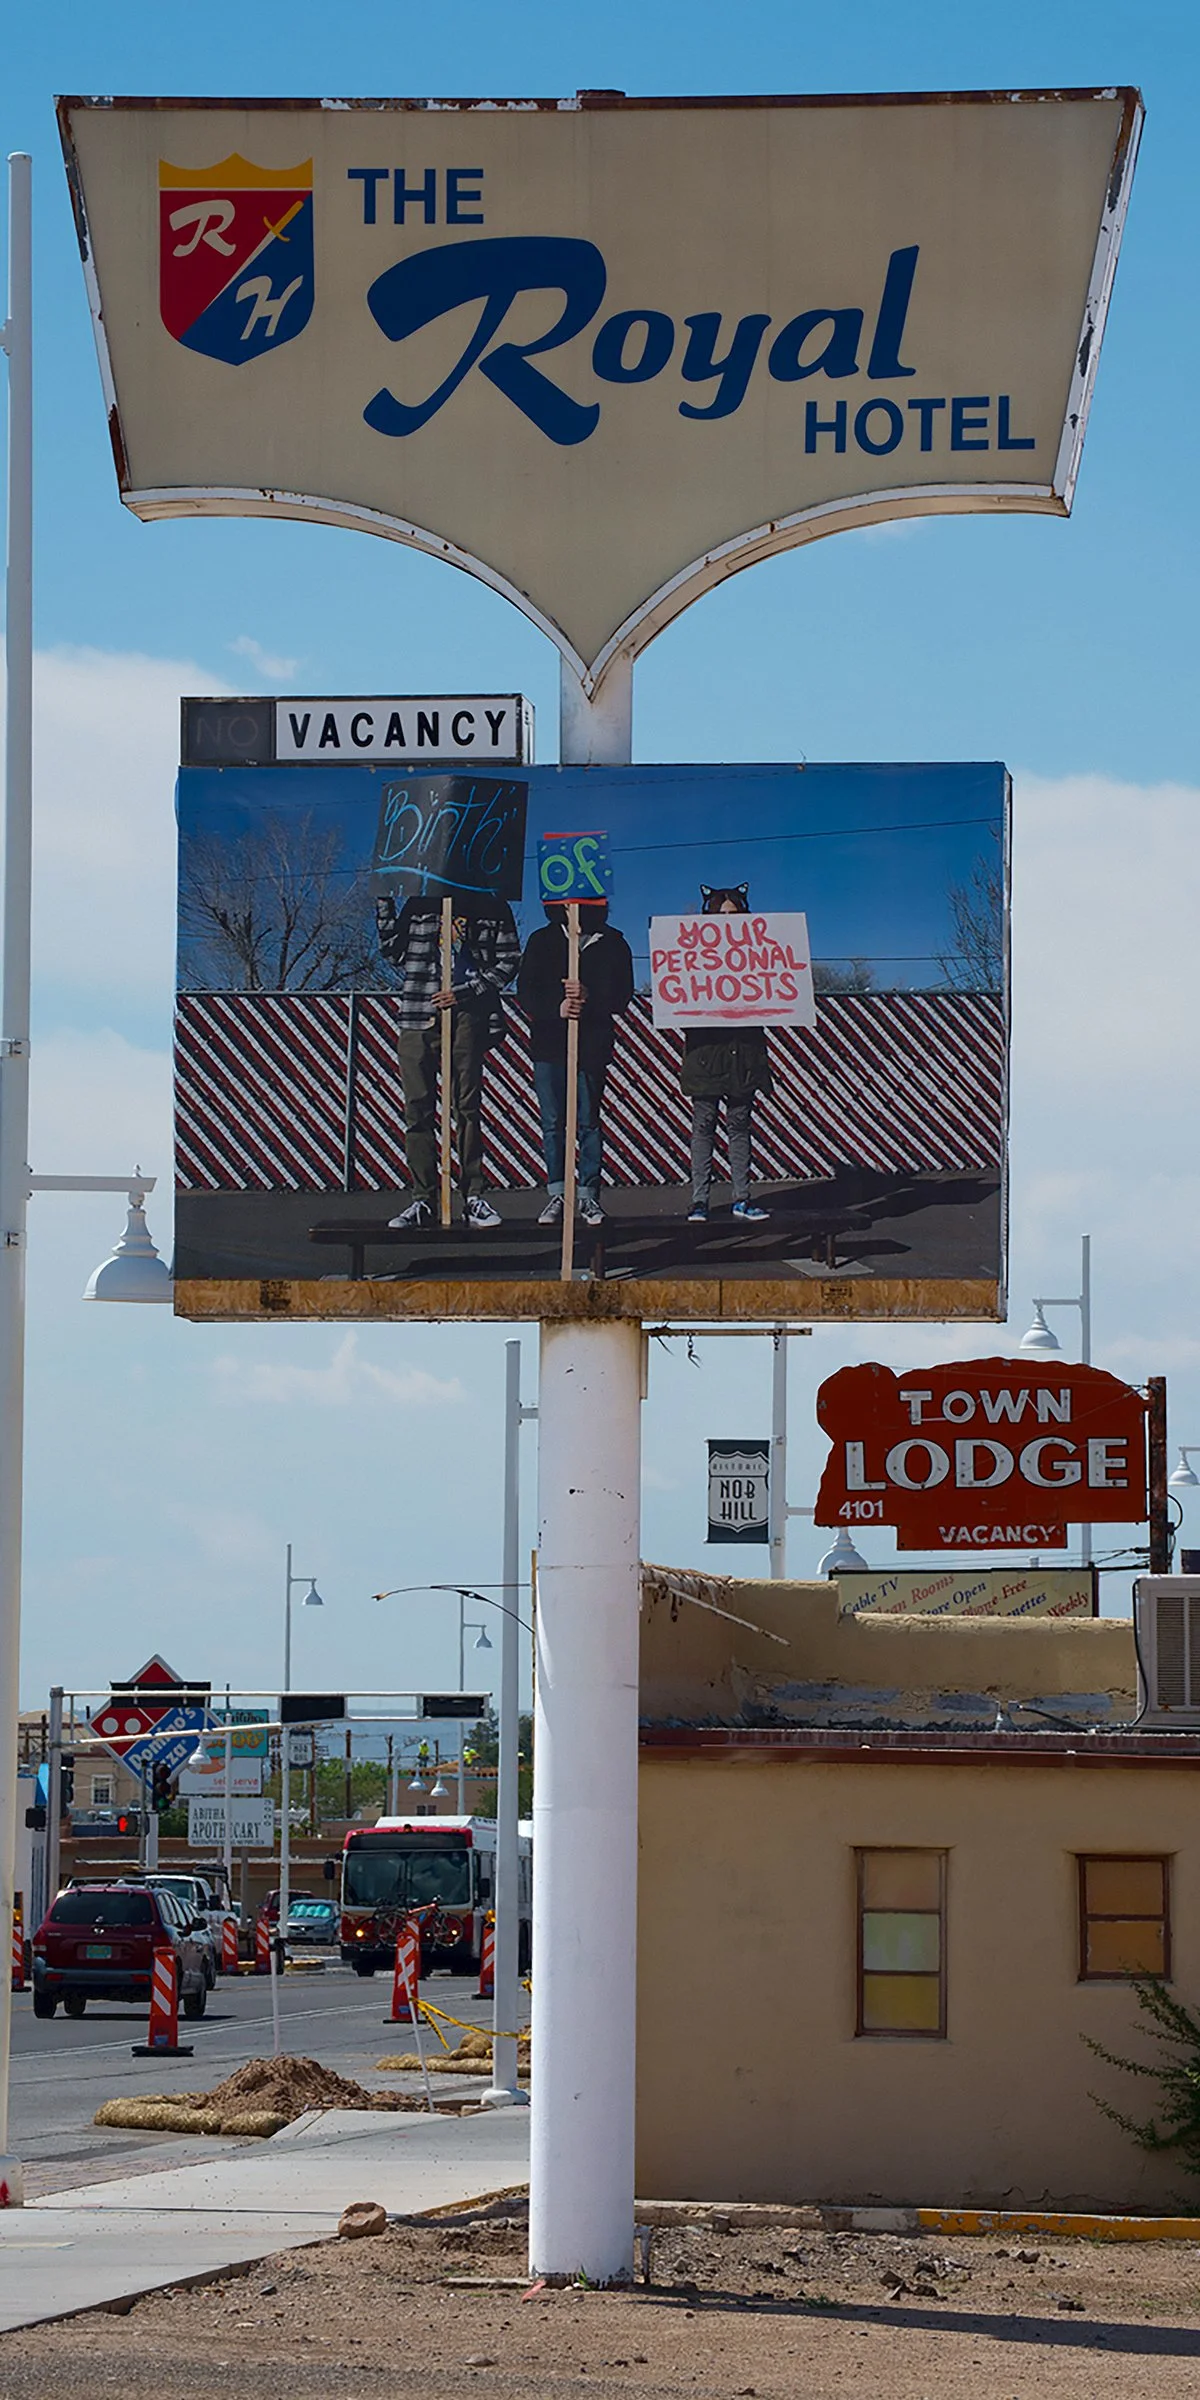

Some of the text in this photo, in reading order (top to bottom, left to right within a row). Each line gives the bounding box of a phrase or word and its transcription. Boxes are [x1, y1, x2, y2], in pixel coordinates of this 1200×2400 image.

[347, 168, 484, 225] THE
[169, 199, 237, 257] R
[235, 274, 304, 341] H
[362, 235, 920, 447] Royal
[804, 394, 1036, 456] HOTEL
[195, 710, 507, 749] NO VACANCY
[378, 785, 508, 875] Birth
[540, 837, 605, 895] of
[677, 917, 778, 950] YOUR
[652, 945, 807, 974] PERSONAL
[658, 971, 799, 1004] GHOSTS
[899, 1388, 1071, 1426] TOWN
[845, 1436, 1129, 1491] LODGE
[720, 1479, 756, 1499] NOB
[719, 1501, 757, 1520] HILL
[838, 1500, 884, 1519] 4101
[938, 1524, 1057, 1544] VACANCY
[841, 1576, 900, 1614] Cable TV
[870, 1574, 956, 1614] lean Rooms
[952, 1581, 987, 1605] Open
[1001, 1579, 1028, 1600] Free
[1046, 1591, 1090, 1617] Weekly
[233, 1778, 259, 1786] serve
[191, 1822, 261, 1839] APOTHCARY
